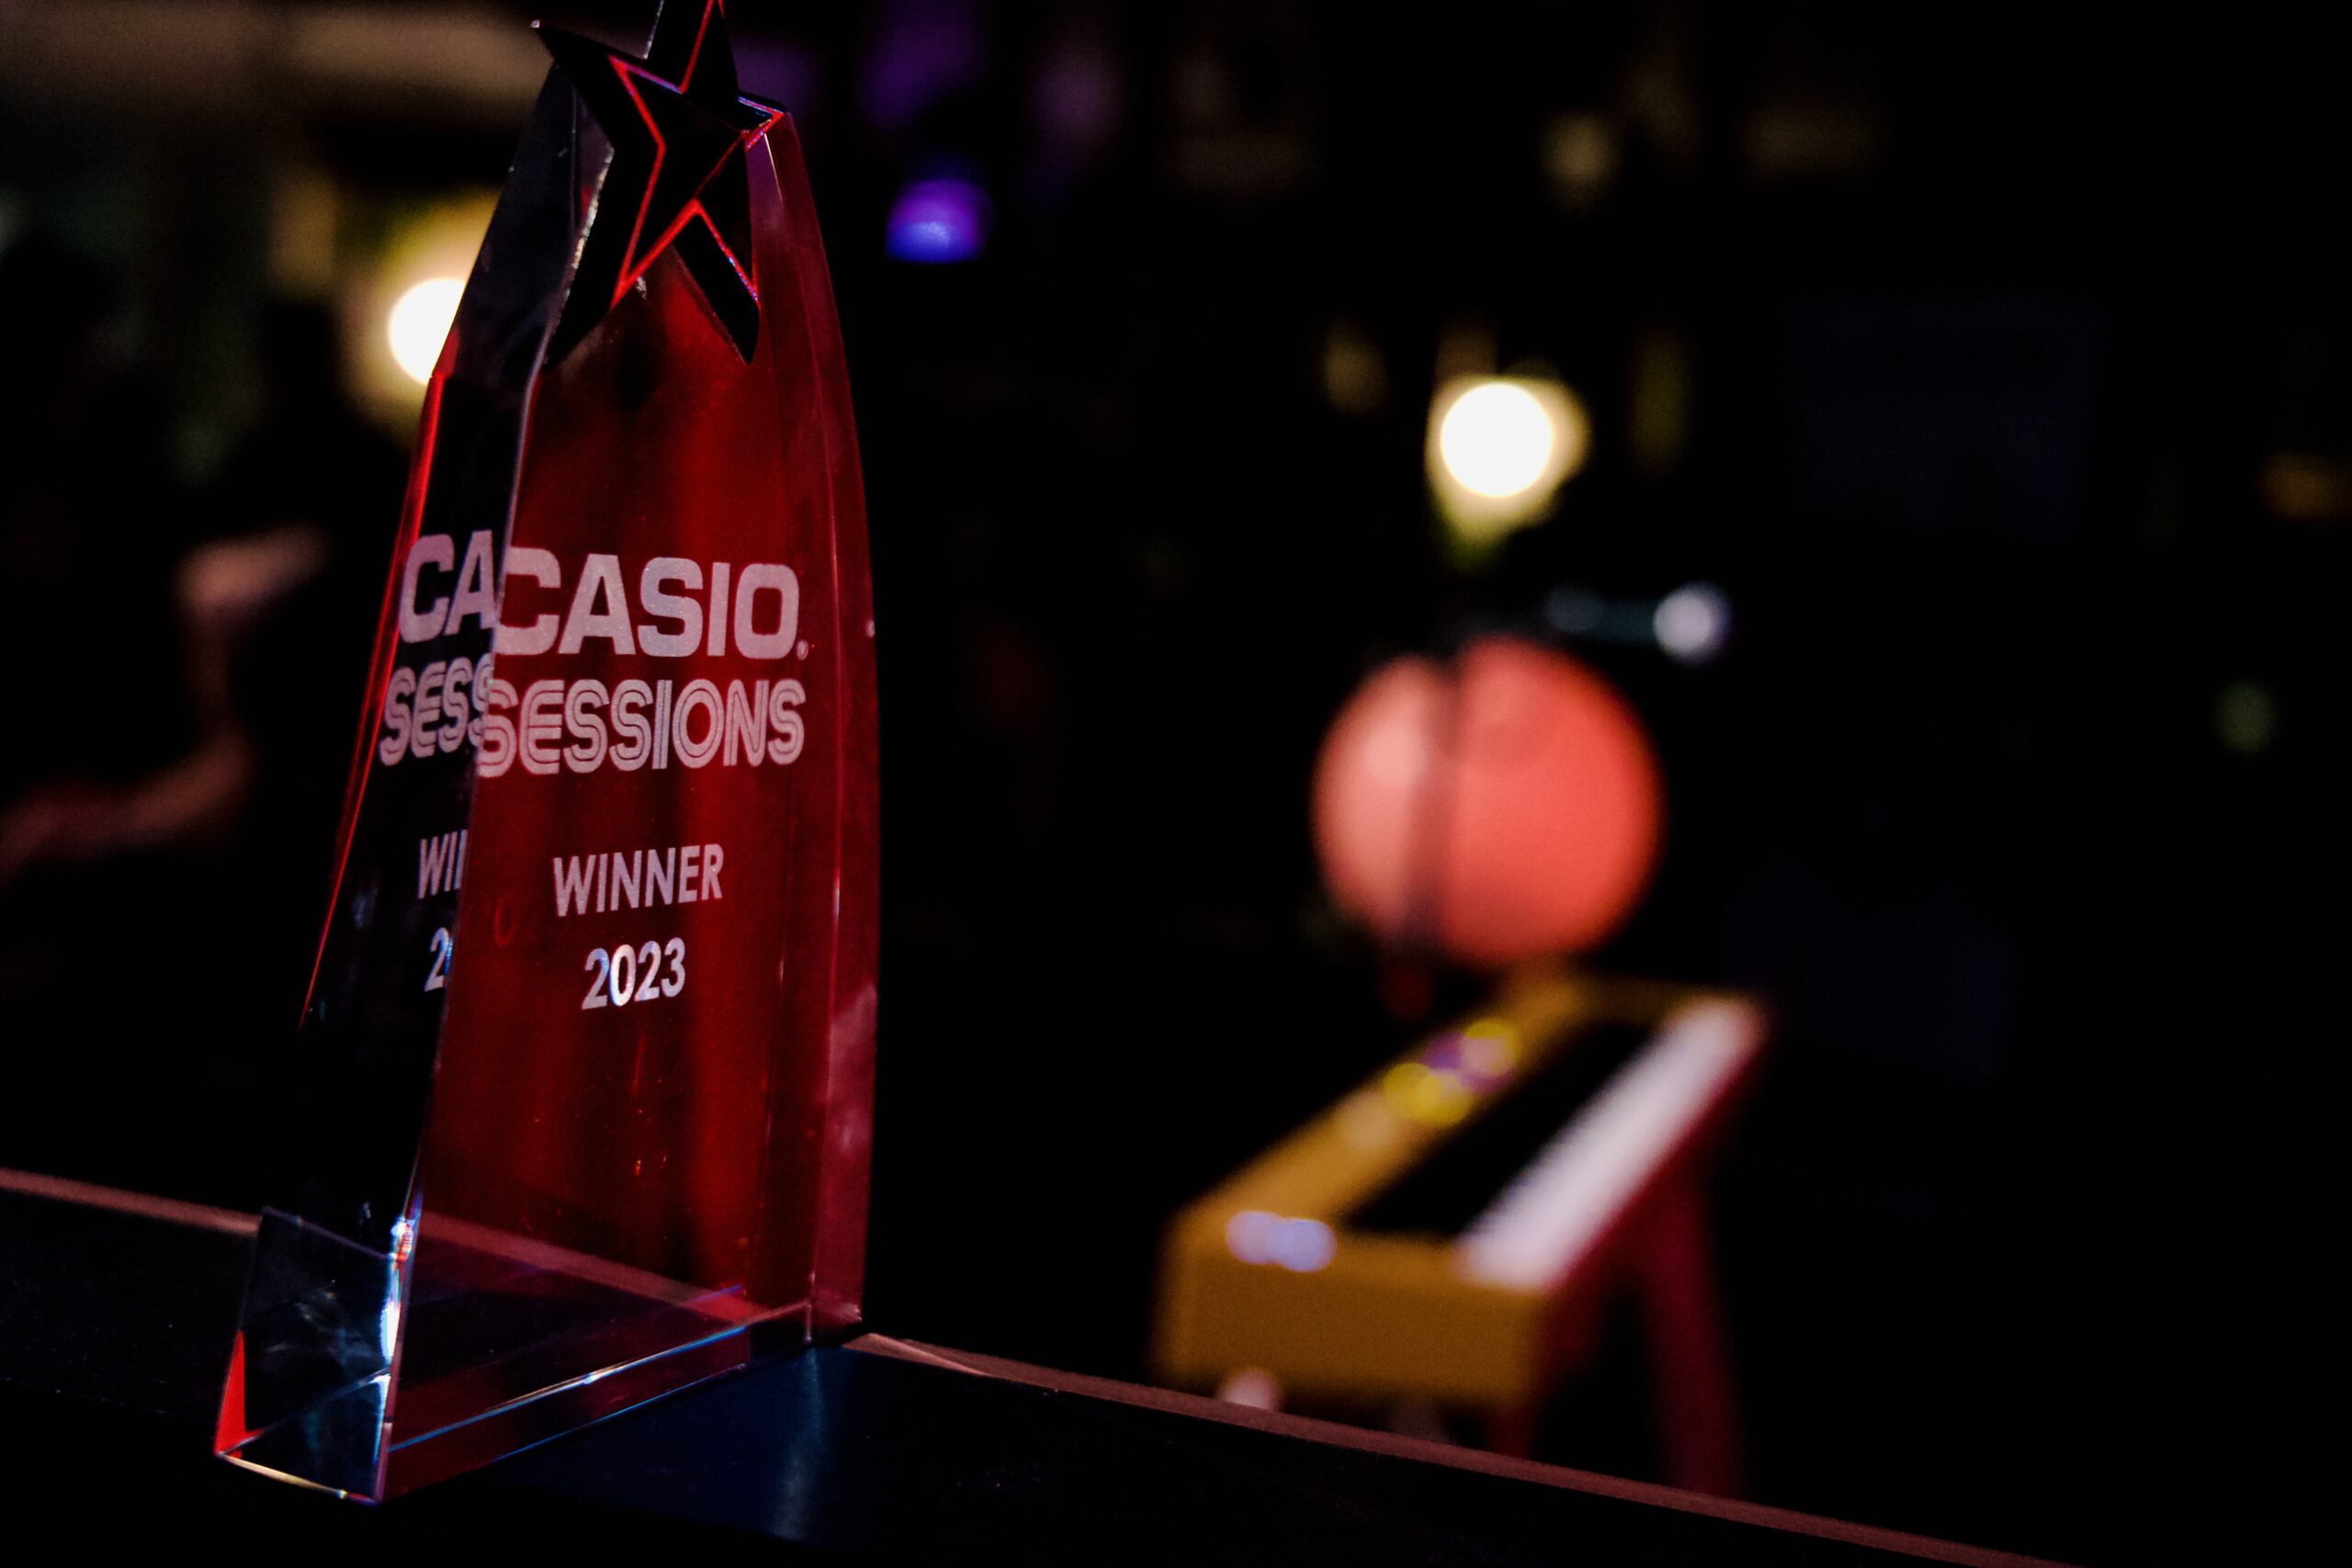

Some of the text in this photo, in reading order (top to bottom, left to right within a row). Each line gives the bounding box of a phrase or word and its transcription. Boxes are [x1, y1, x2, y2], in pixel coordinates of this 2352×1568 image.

[492, 547, 799, 660] CASIO
[477, 678, 807, 778] SESSIONS
[553, 843, 724, 917] WINNER
[582, 937, 685, 1010] 2023
